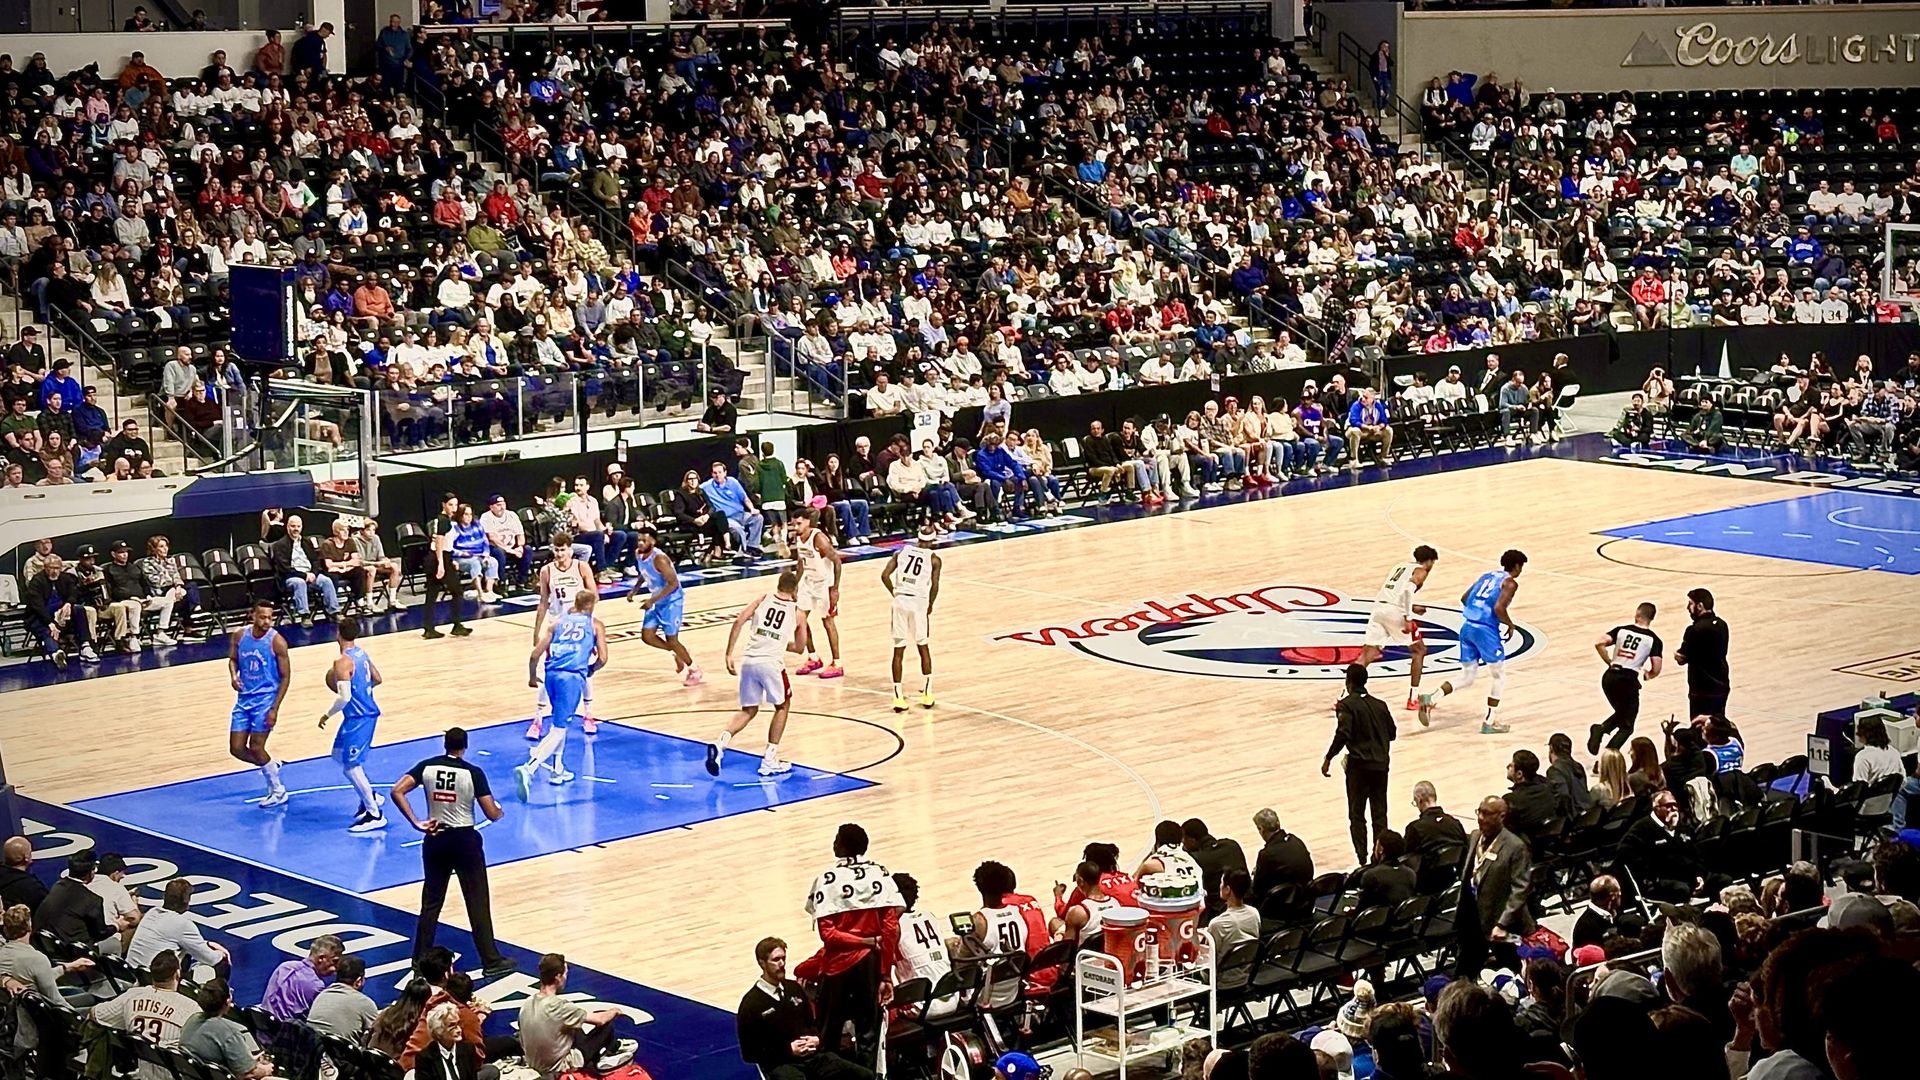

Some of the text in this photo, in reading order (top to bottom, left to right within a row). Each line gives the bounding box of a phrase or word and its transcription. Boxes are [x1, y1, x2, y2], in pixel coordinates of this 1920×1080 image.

[1676, 22, 1920, 67] Coors LIGHT
[1828, 309, 1841, 321] 34
[918, 414, 932, 426] 32
[1599, 453, 1920, 494] SAN DIE
[903, 555, 923, 576] 76
[1475, 579, 1495, 599] 12
[763, 607, 786, 630] 99
[993, 585, 1341, 646] Clippers
[558, 621, 587, 641] 25
[1622, 634, 1642, 651] 26
[1809, 748, 1830, 761] 115
[435, 770, 457, 791] 52
[912, 919, 942, 949] 44
[997, 920, 1022, 951] 50
[1179, 921, 1194, 939] G
[1083, 971, 1116, 986] GATORADE
[132, 999, 161, 1014] TATIS
